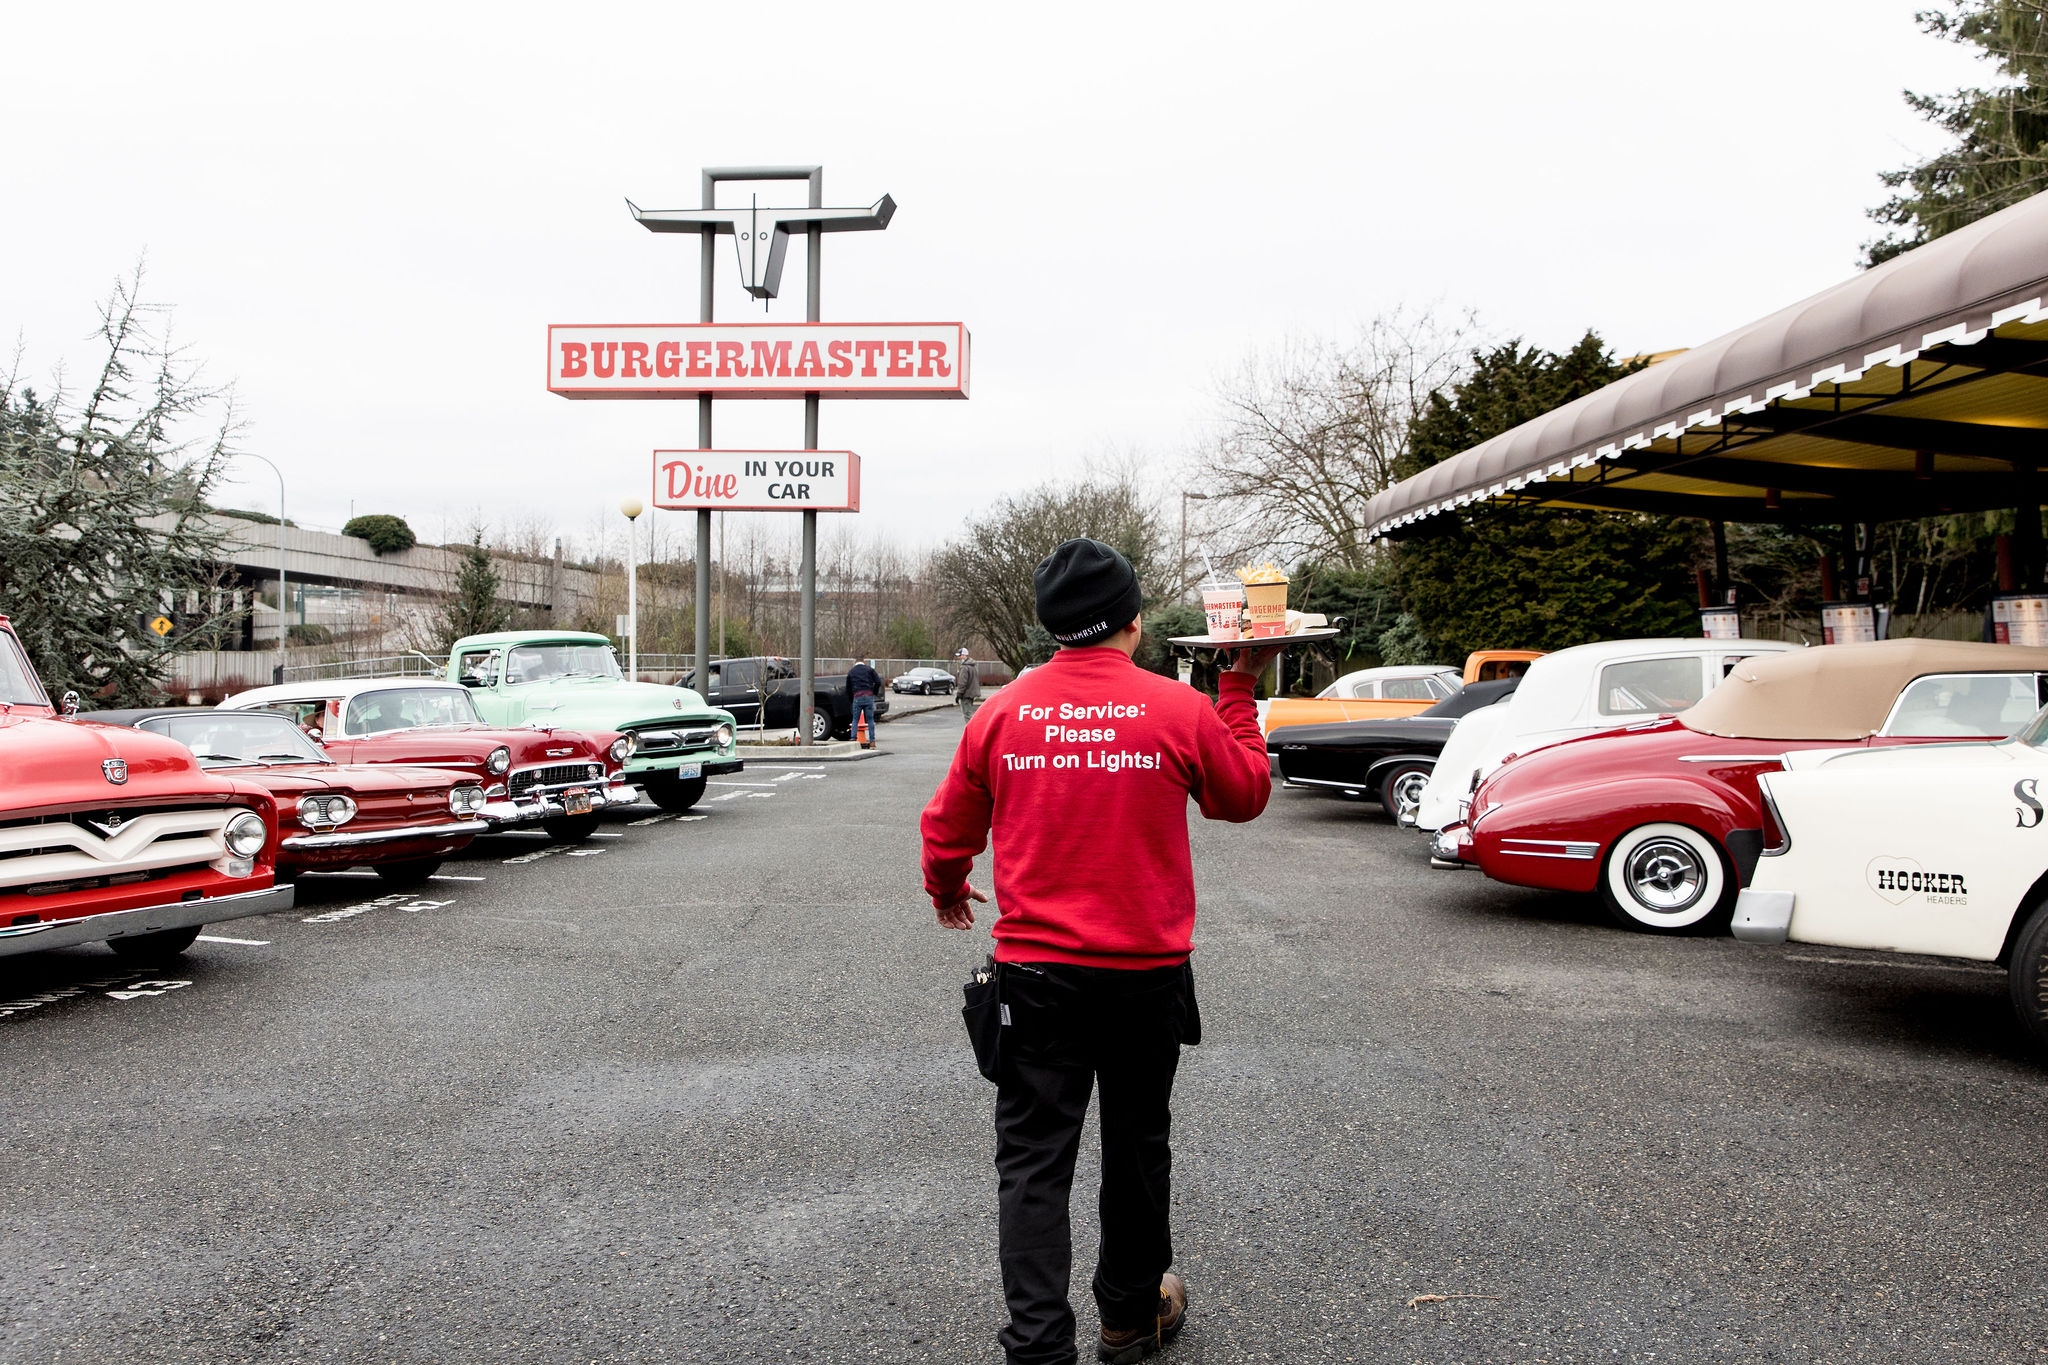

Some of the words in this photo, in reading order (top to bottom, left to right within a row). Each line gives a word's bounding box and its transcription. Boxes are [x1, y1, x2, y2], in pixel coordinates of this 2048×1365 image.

[560, 340, 951, 378] BURGERMASTER
[662, 460, 739, 500] Dine
[744, 461, 767, 477] IN
[775, 461, 835, 478] YOUR
[767, 483, 811, 500] CAR
[1018, 704, 1054, 721] For
[1058, 701, 1146, 720] Service:
[1045, 725, 1116, 743] Please
[1002, 753, 1046, 771] Turn
[1052, 755, 1080, 769] on
[1087, 750, 1161, 772] Lights!
[1878, 869, 1968, 894] HOOKER
[1926, 896, 1967, 905] HEADERS
